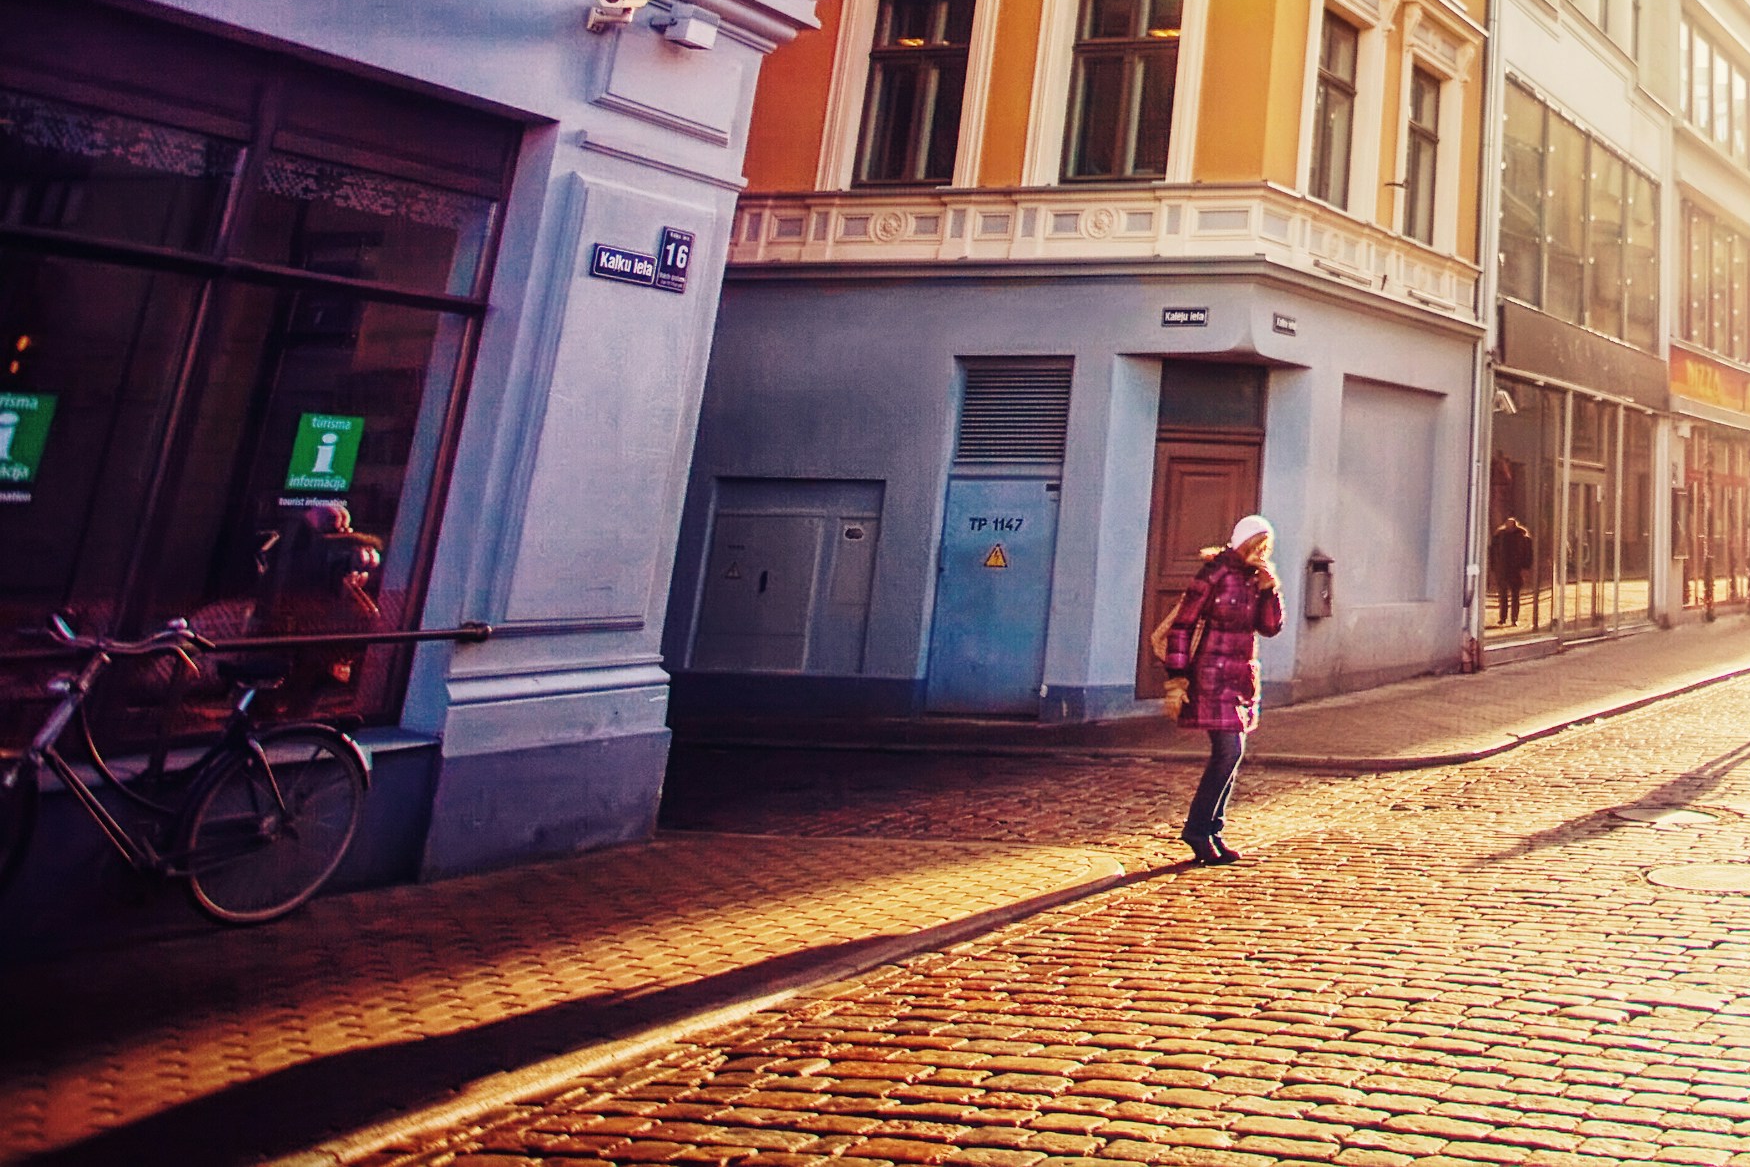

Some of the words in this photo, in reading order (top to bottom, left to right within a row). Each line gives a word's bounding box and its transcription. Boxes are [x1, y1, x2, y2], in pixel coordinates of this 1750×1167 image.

[666, 242, 689, 270] 16
[633, 258, 654, 277] iela
[969, 517, 988, 532] TP
[993, 517, 1024, 532] 1147
